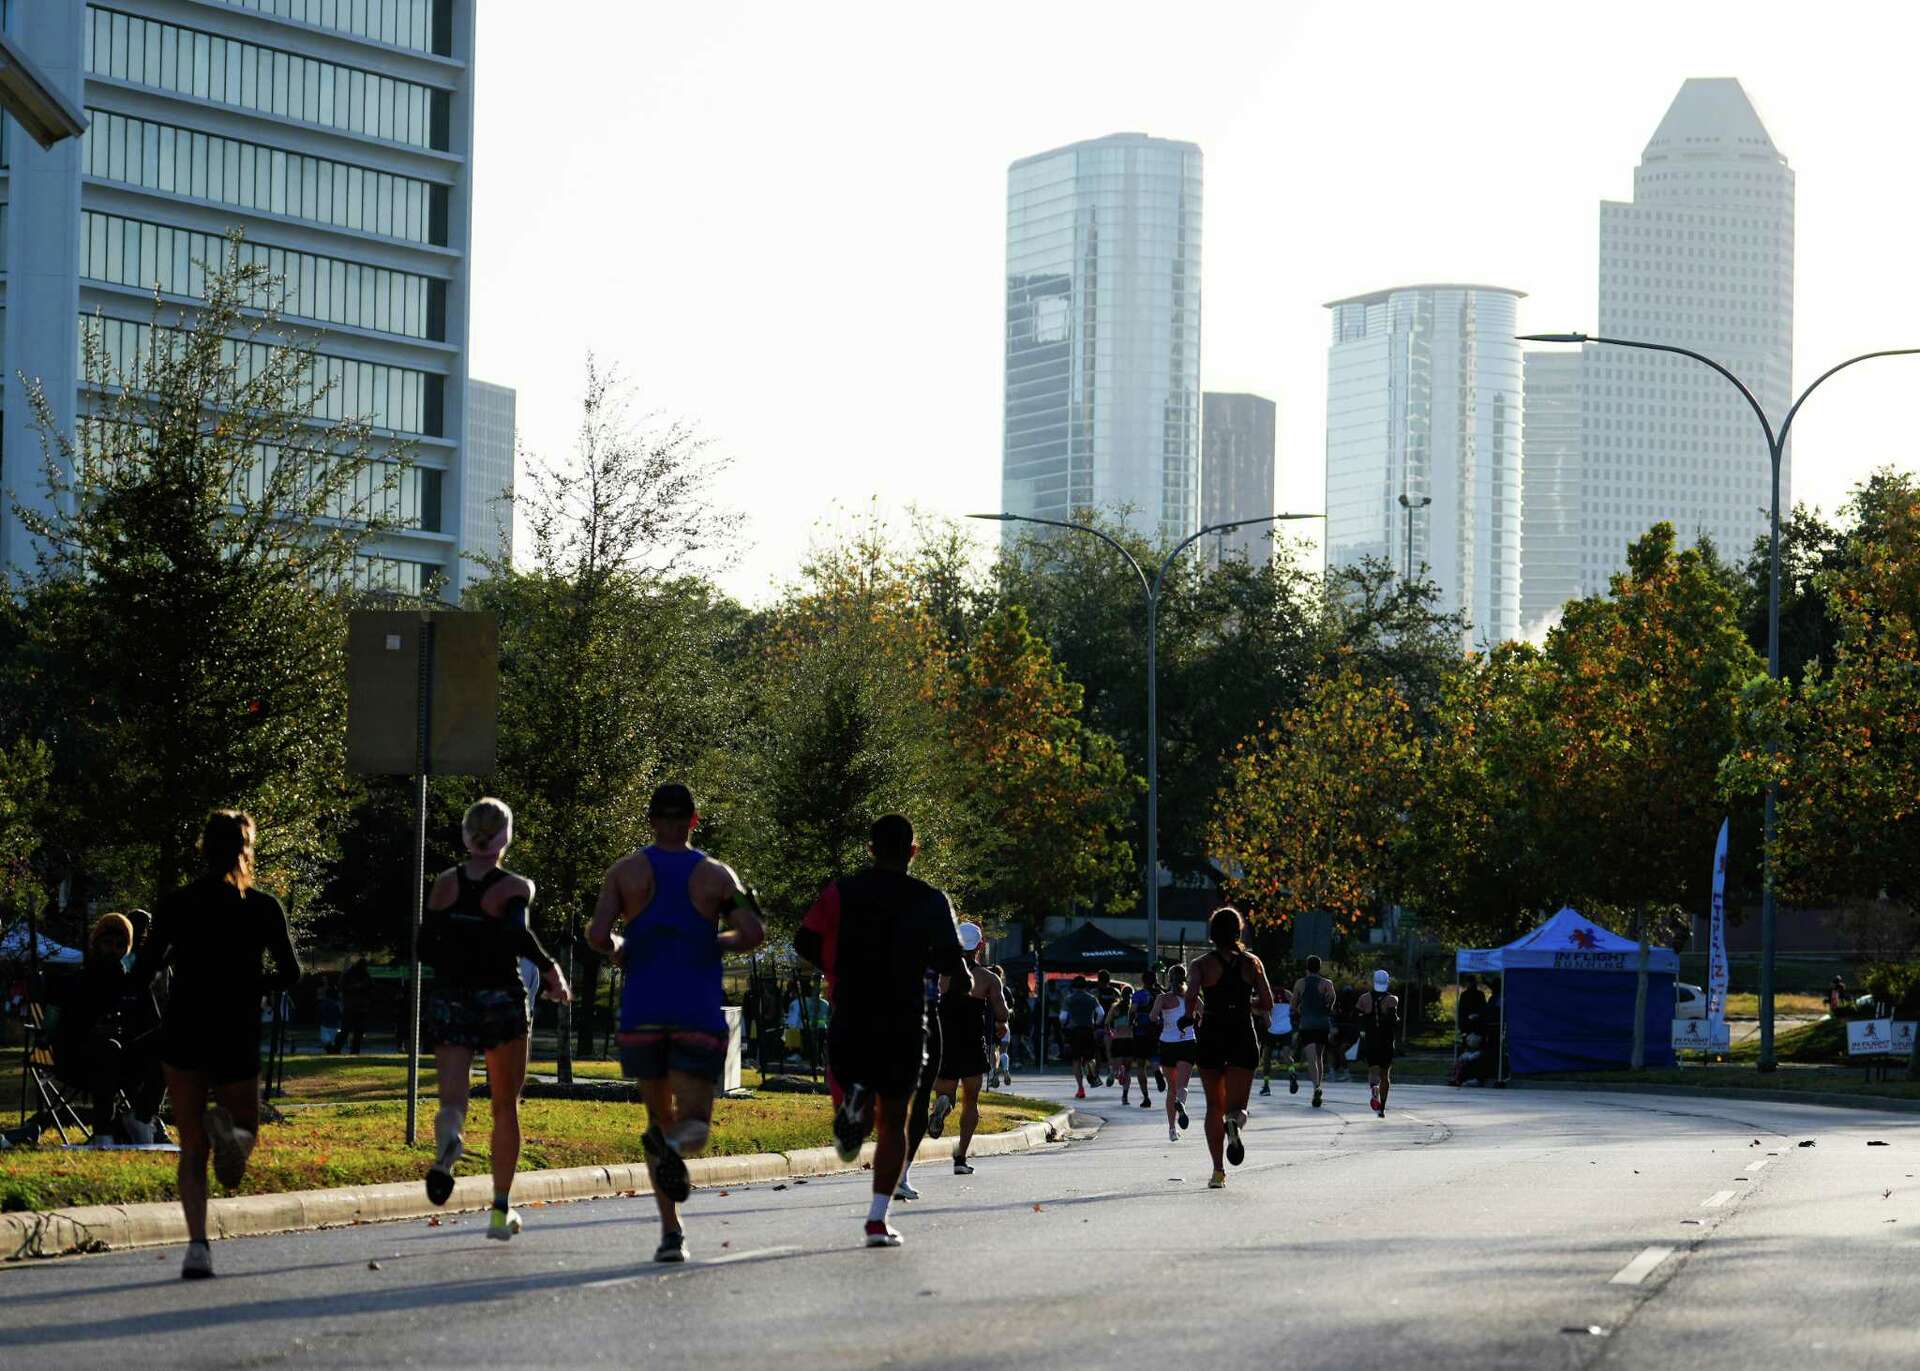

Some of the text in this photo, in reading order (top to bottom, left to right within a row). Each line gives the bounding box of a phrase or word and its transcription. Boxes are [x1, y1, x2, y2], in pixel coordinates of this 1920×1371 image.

[1554, 952, 1630, 961] IN FLIGHT
[1553, 961, 1625, 969] RUNNING
